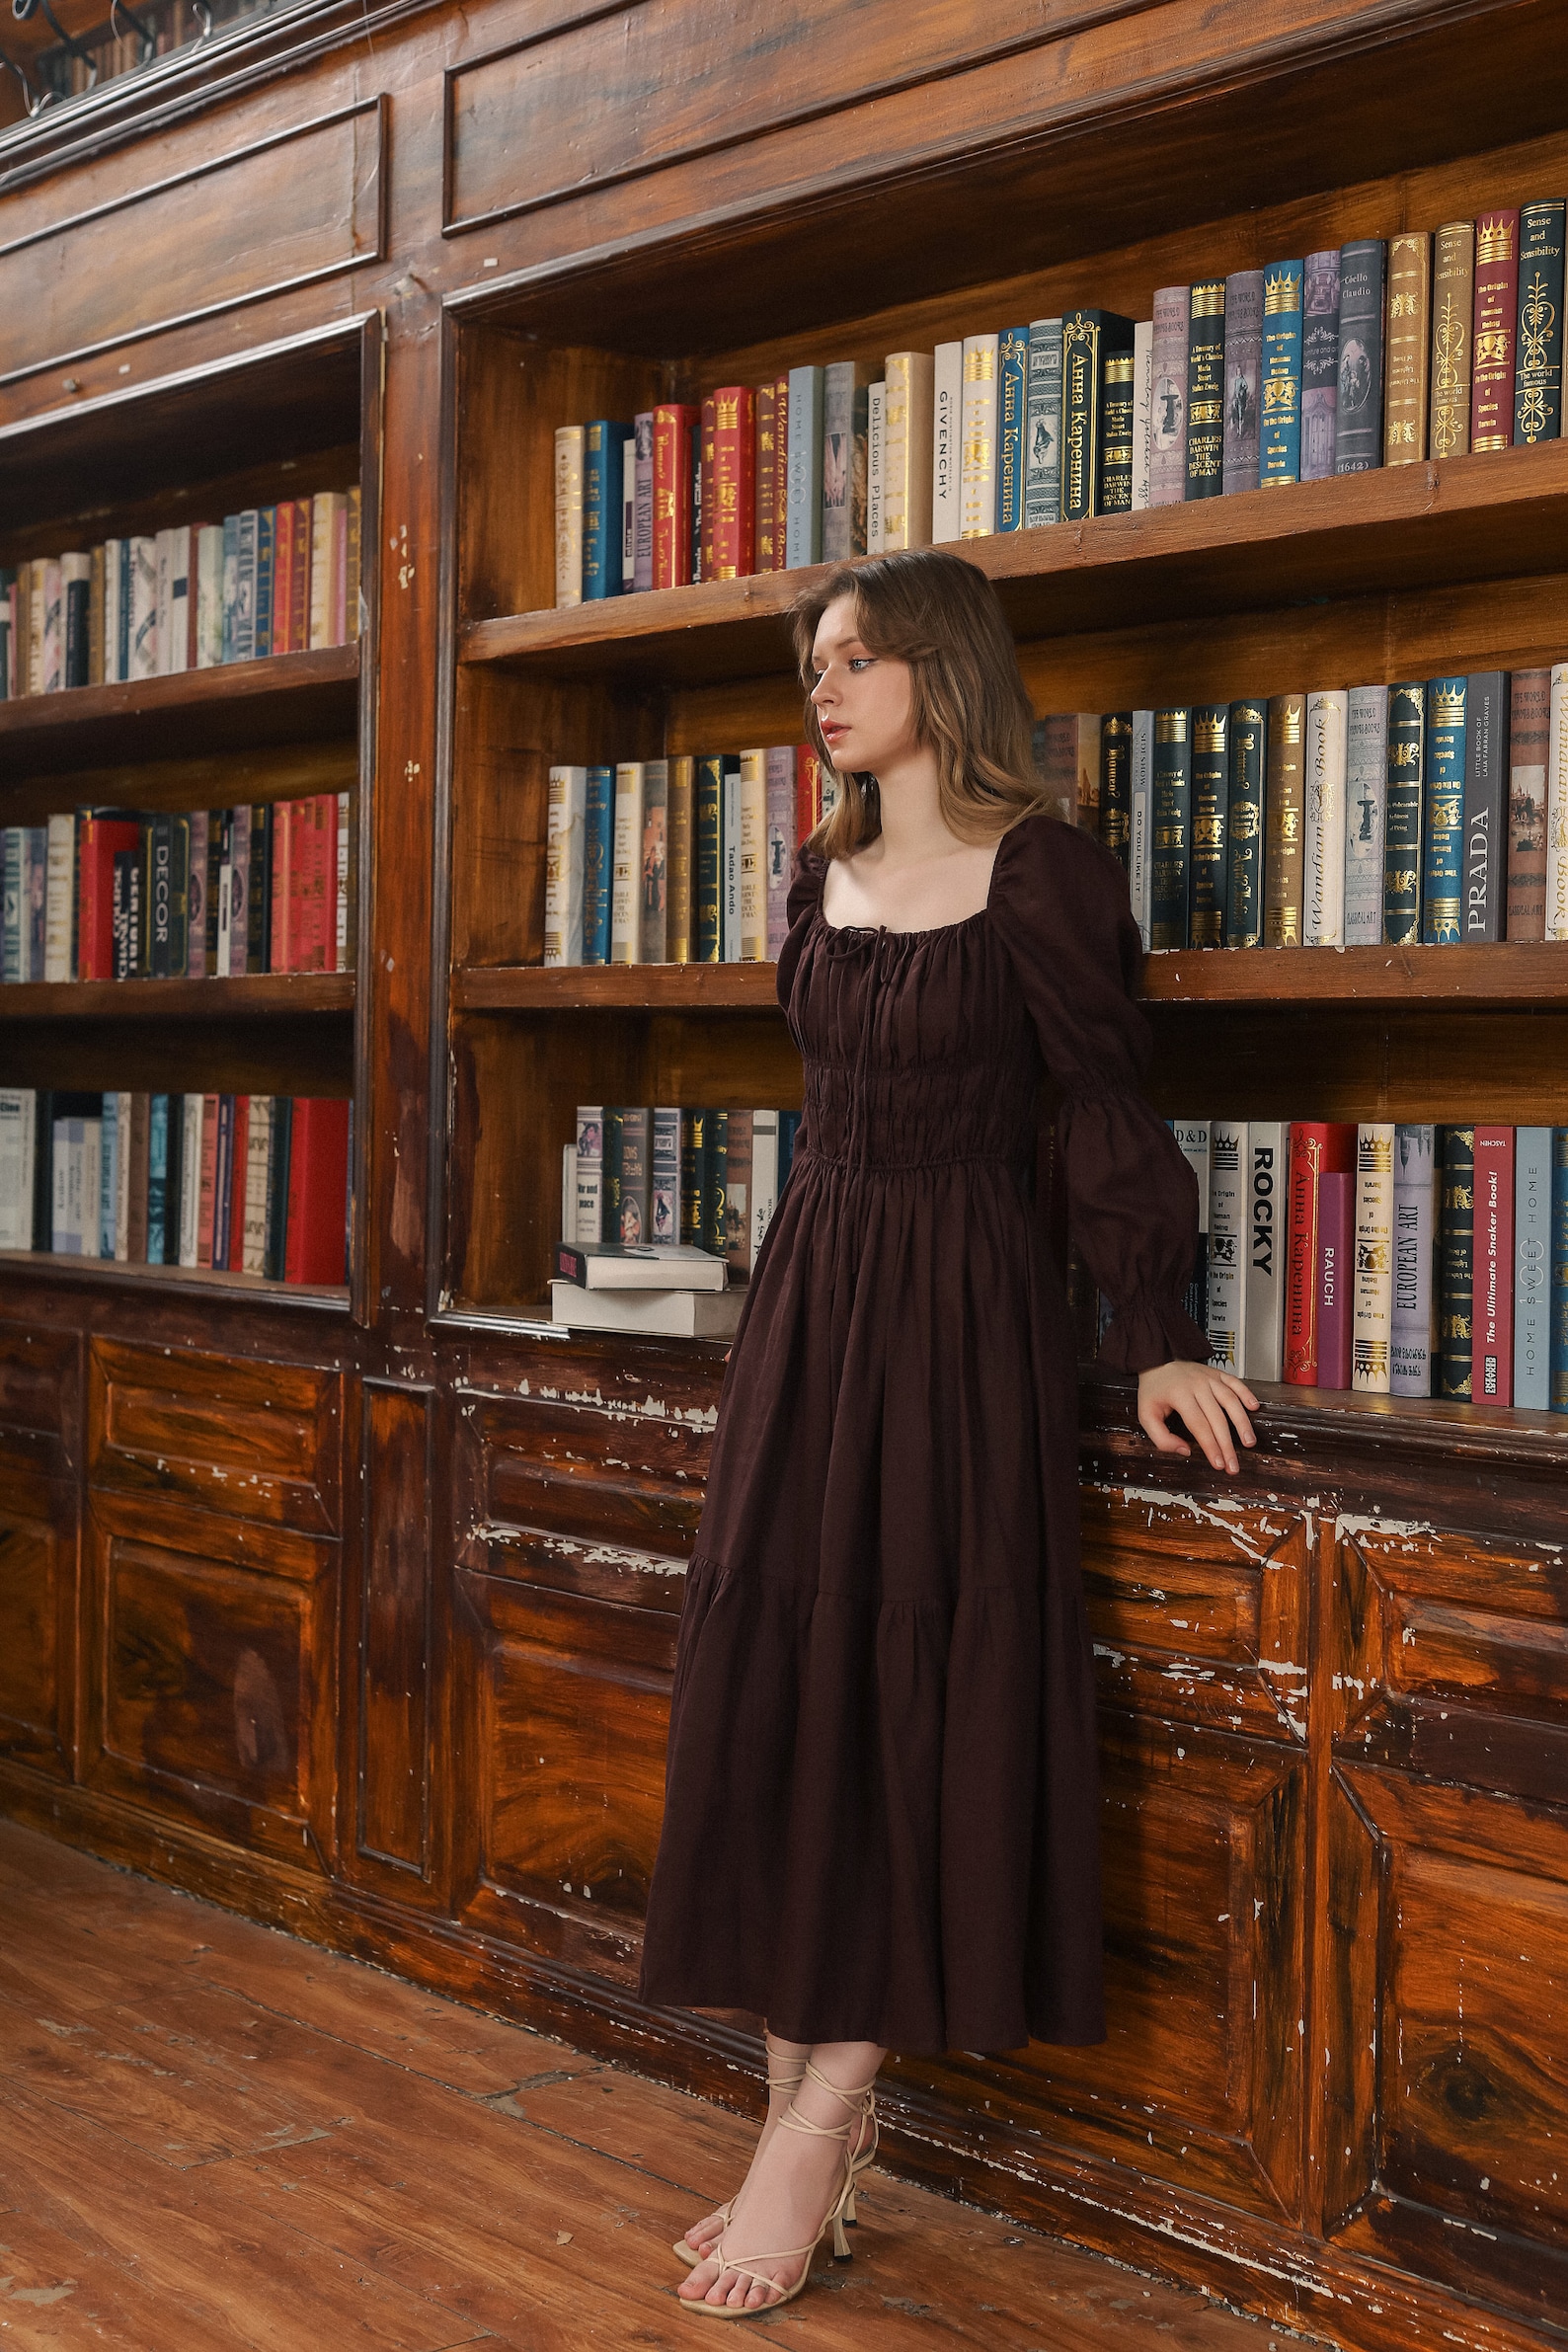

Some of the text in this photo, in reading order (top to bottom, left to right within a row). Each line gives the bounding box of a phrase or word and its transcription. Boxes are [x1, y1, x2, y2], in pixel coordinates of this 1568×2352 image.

[1527, 216, 1551, 229] Sense
[1529, 230, 1546, 242] and
[1440, 238, 1462, 251] Sense
[1443, 253, 1456, 263] and
[1520, 246, 1561, 261] Sensibility
[1342, 286, 1371, 299] Claudio
[1478, 281, 1509, 293] The Origin
[1480, 306, 1503, 317] Human
[1481, 319, 1501, 329] Being
[1266, 332, 1296, 343] The Origin
[1320, 346, 1332, 354] and
[1488, 371, 1507, 381] Origin
[1521, 369, 1553, 382] The world
[1524, 377, 1546, 387] famous
[1444, 387, 1463, 396] world
[1484, 387, 1491, 396] of
[1436, 396, 1457, 406] famous
[1478, 402, 1499, 413] Species
[1477, 418, 1497, 430] Darwin
[1068, 353, 1088, 510] Анна Каренина
[777, 398, 788, 486] Wandian
[938, 391, 948, 500] GIVENCHY
[1189, 434, 1222, 446] CHARLES
[1001, 371, 1019, 524] Анна Каренина
[1189, 443, 1219, 455] DARWIN
[1195, 452, 1211, 461] THE
[871, 398, 882, 537] Delicious Places
[1188, 459, 1221, 471] DESCENT
[1337, 460, 1370, 474] (1642)
[1199, 467, 1217, 476] MAN
[1104, 481, 1132, 490] DARWIN
[1113, 498, 1131, 507] MAN
[637, 478, 652, 558] EUROPEAN ART
[1476, 717, 1482, 728] OF
[1137, 810, 1142, 826] DO
[1309, 711, 1330, 930] Wandian Book
[1467, 807, 1489, 933] PRADA
[1136, 882, 1140, 892] IT
[1554, 855, 1568, 925] Book
[156, 844, 169, 943] DECOR
[1530, 904, 1543, 916] ART
[1488, 1170, 1498, 1208] Book!
[1252, 1147, 1274, 1277] ROCKY
[1487, 1211, 1497, 1257] Snaker
[1292, 1172, 1311, 1336] Анна Каренина
[1395, 1203, 1419, 1310] EUROPEAN ART
[1218, 1272, 1234, 1281] Origin
[1323, 1247, 1335, 1306] RAUCH
[1526, 1166, 1537, 1376] HOME SWEET HOME
[1486, 1321, 1496, 1344] The
